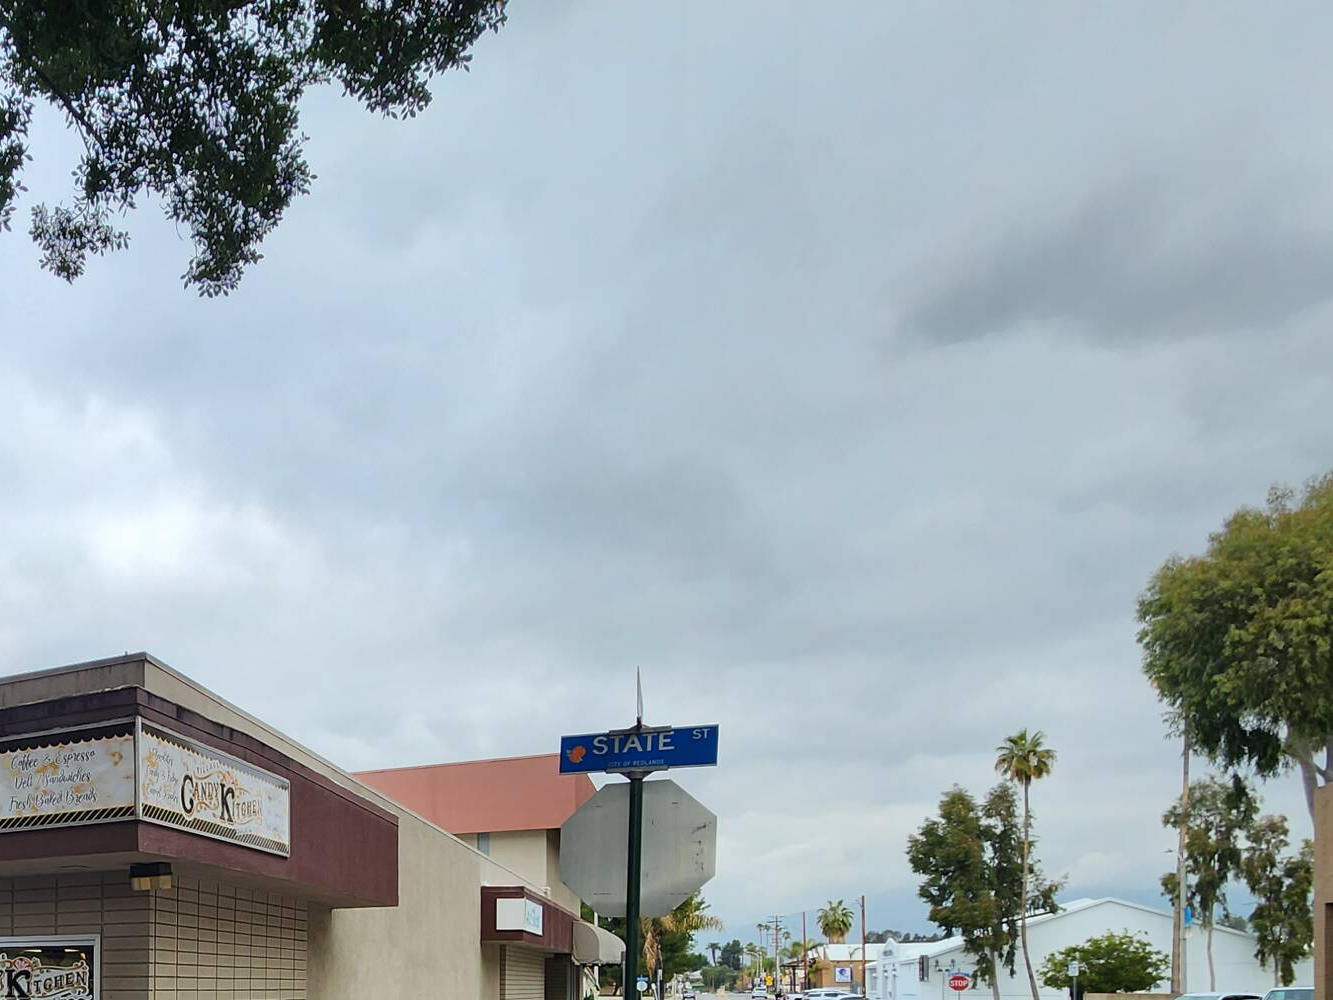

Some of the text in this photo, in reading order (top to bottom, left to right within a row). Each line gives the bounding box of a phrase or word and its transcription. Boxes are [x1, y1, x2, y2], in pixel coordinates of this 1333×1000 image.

[592, 728, 710, 755] STATE ST
[608, 760, 621, 768] CITY
[633, 758, 665, 767] REDLANDS
[181, 775, 219, 814] CANDY
[219, 783, 263, 823] KITCHEN
[5, 969, 86, 999] KITCHEN
[950, 979, 968, 987] STOP
